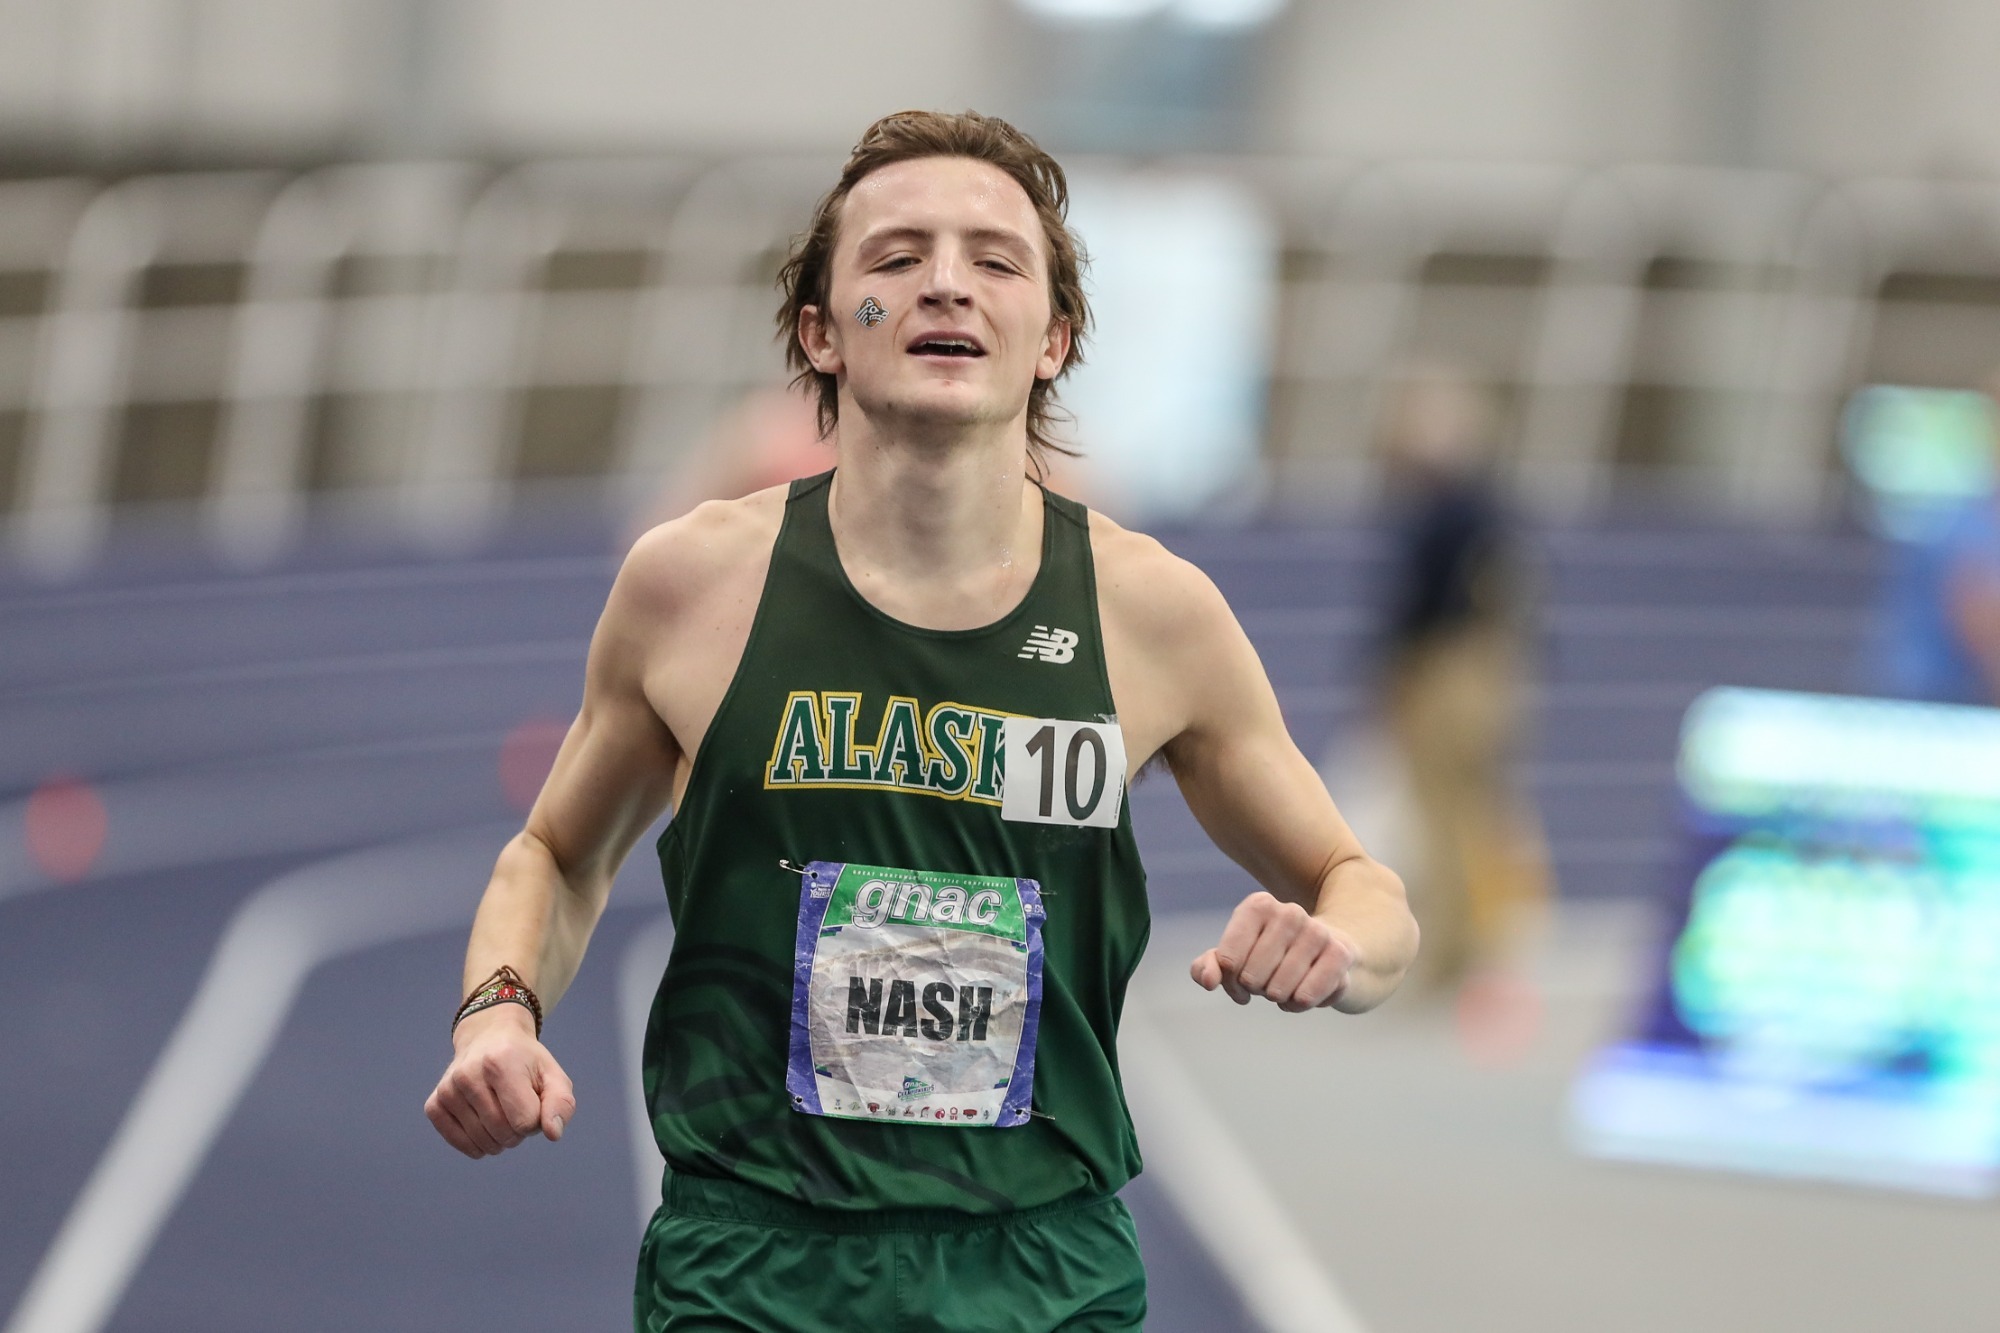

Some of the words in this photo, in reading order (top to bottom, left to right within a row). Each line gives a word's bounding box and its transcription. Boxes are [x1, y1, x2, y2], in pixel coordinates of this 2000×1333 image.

[764, 691, 1003, 807] ALASK
[1025, 725, 1107, 821] 10
[852, 879, 1001, 929] gnac
[846, 976, 993, 1042] NASH
